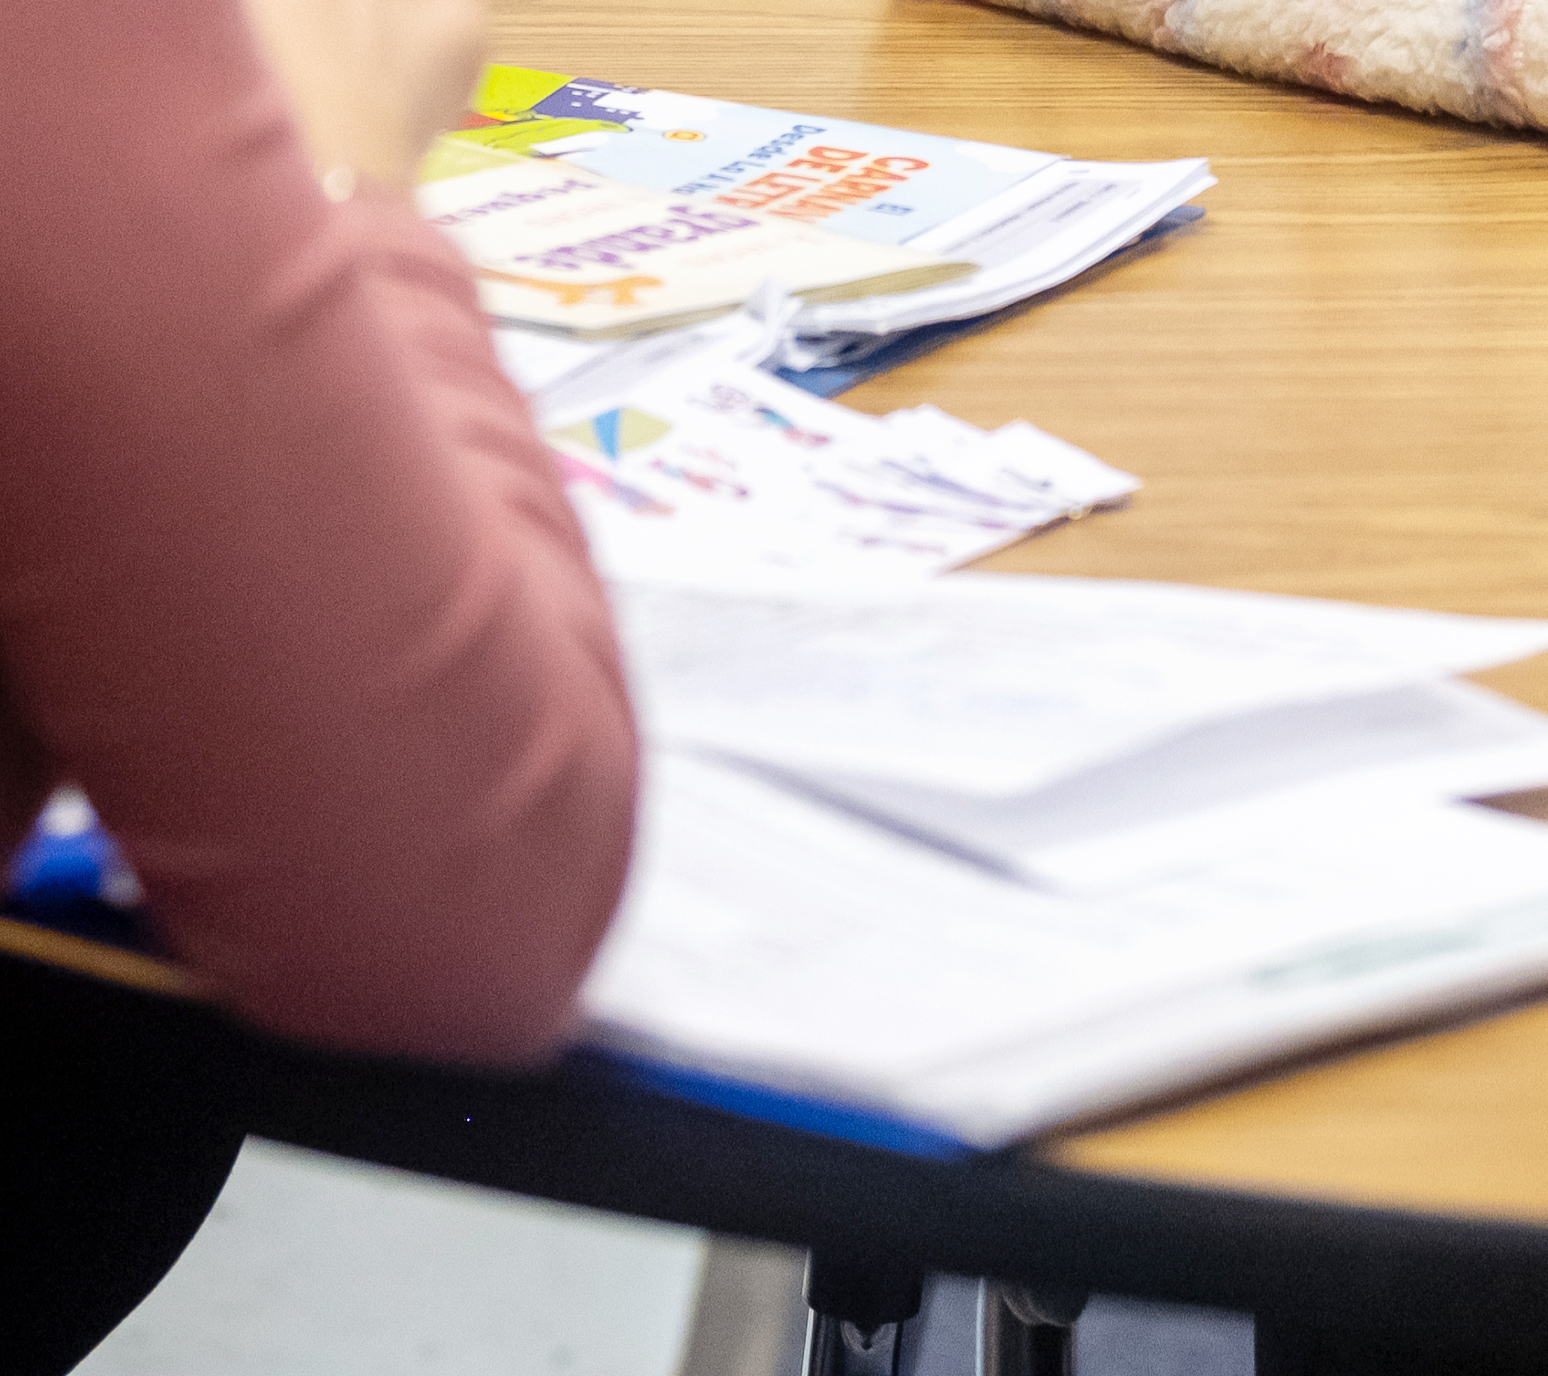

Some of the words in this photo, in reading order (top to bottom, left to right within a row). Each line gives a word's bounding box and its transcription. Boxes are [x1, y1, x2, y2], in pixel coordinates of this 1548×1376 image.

[746, 124, 827, 159] Desde
[785, 146, 870, 174] DE
[712, 172, 822, 209] LETR
[766, 156, 930, 224] CARNAV
